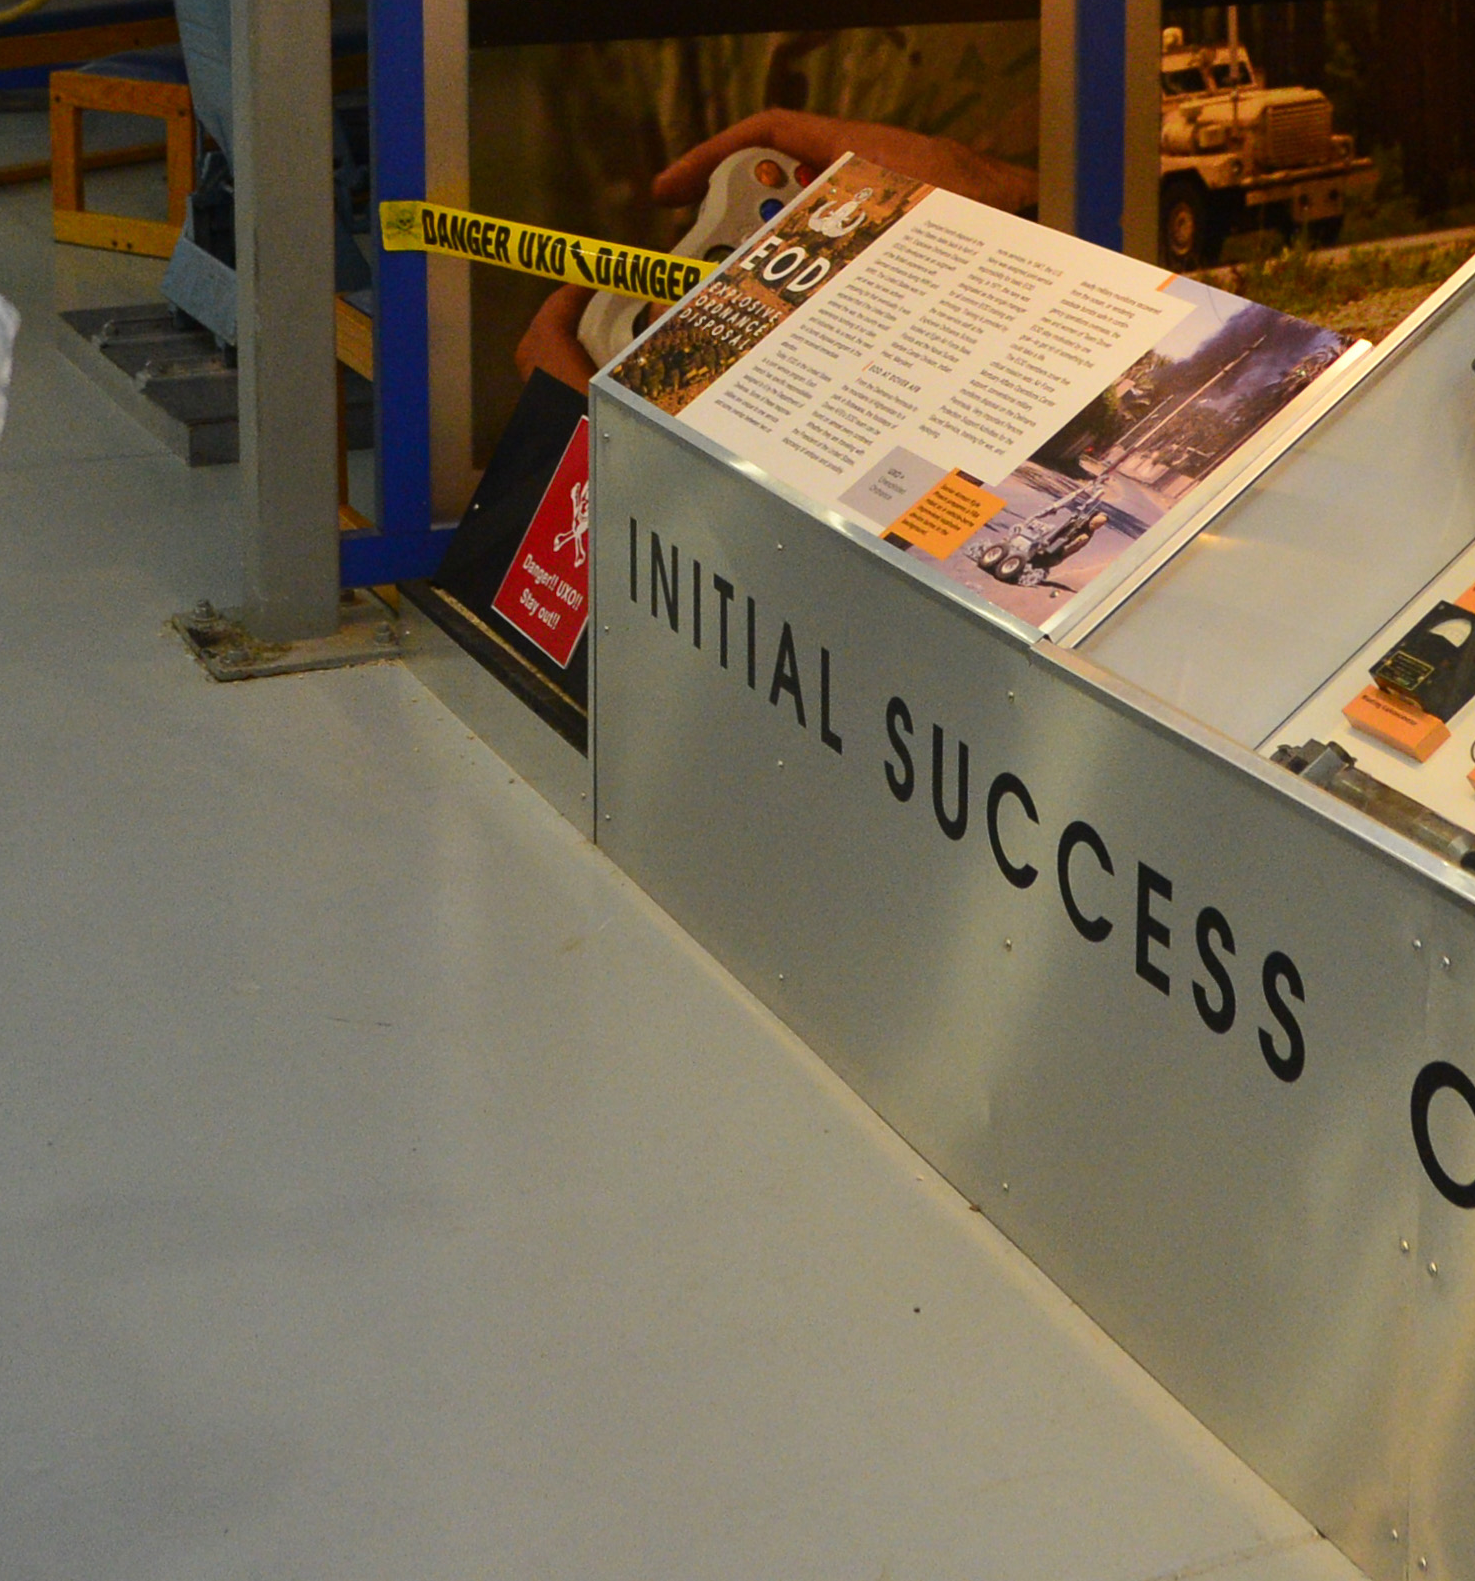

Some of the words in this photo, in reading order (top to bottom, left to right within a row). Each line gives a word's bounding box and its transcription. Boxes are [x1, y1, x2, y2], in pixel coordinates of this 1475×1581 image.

[421, 209, 511, 264] DANGER
[518, 230, 566, 276] UXO
[739, 235, 831, 293] EOD
[695, 295, 768, 337] ORDNANCE
[708, 281, 784, 324] EXPLOSIVE
[679, 308, 751, 351] DISPOSAL
[523, 553, 560, 591] Danger!!
[556, 580, 584, 611] UXO!!
[520, 588, 540, 616] Stay
[538, 607, 561, 630] out!!
[630, 516, 842, 755] INITIAL
[884, 696, 1306, 1083] SUCCESS
